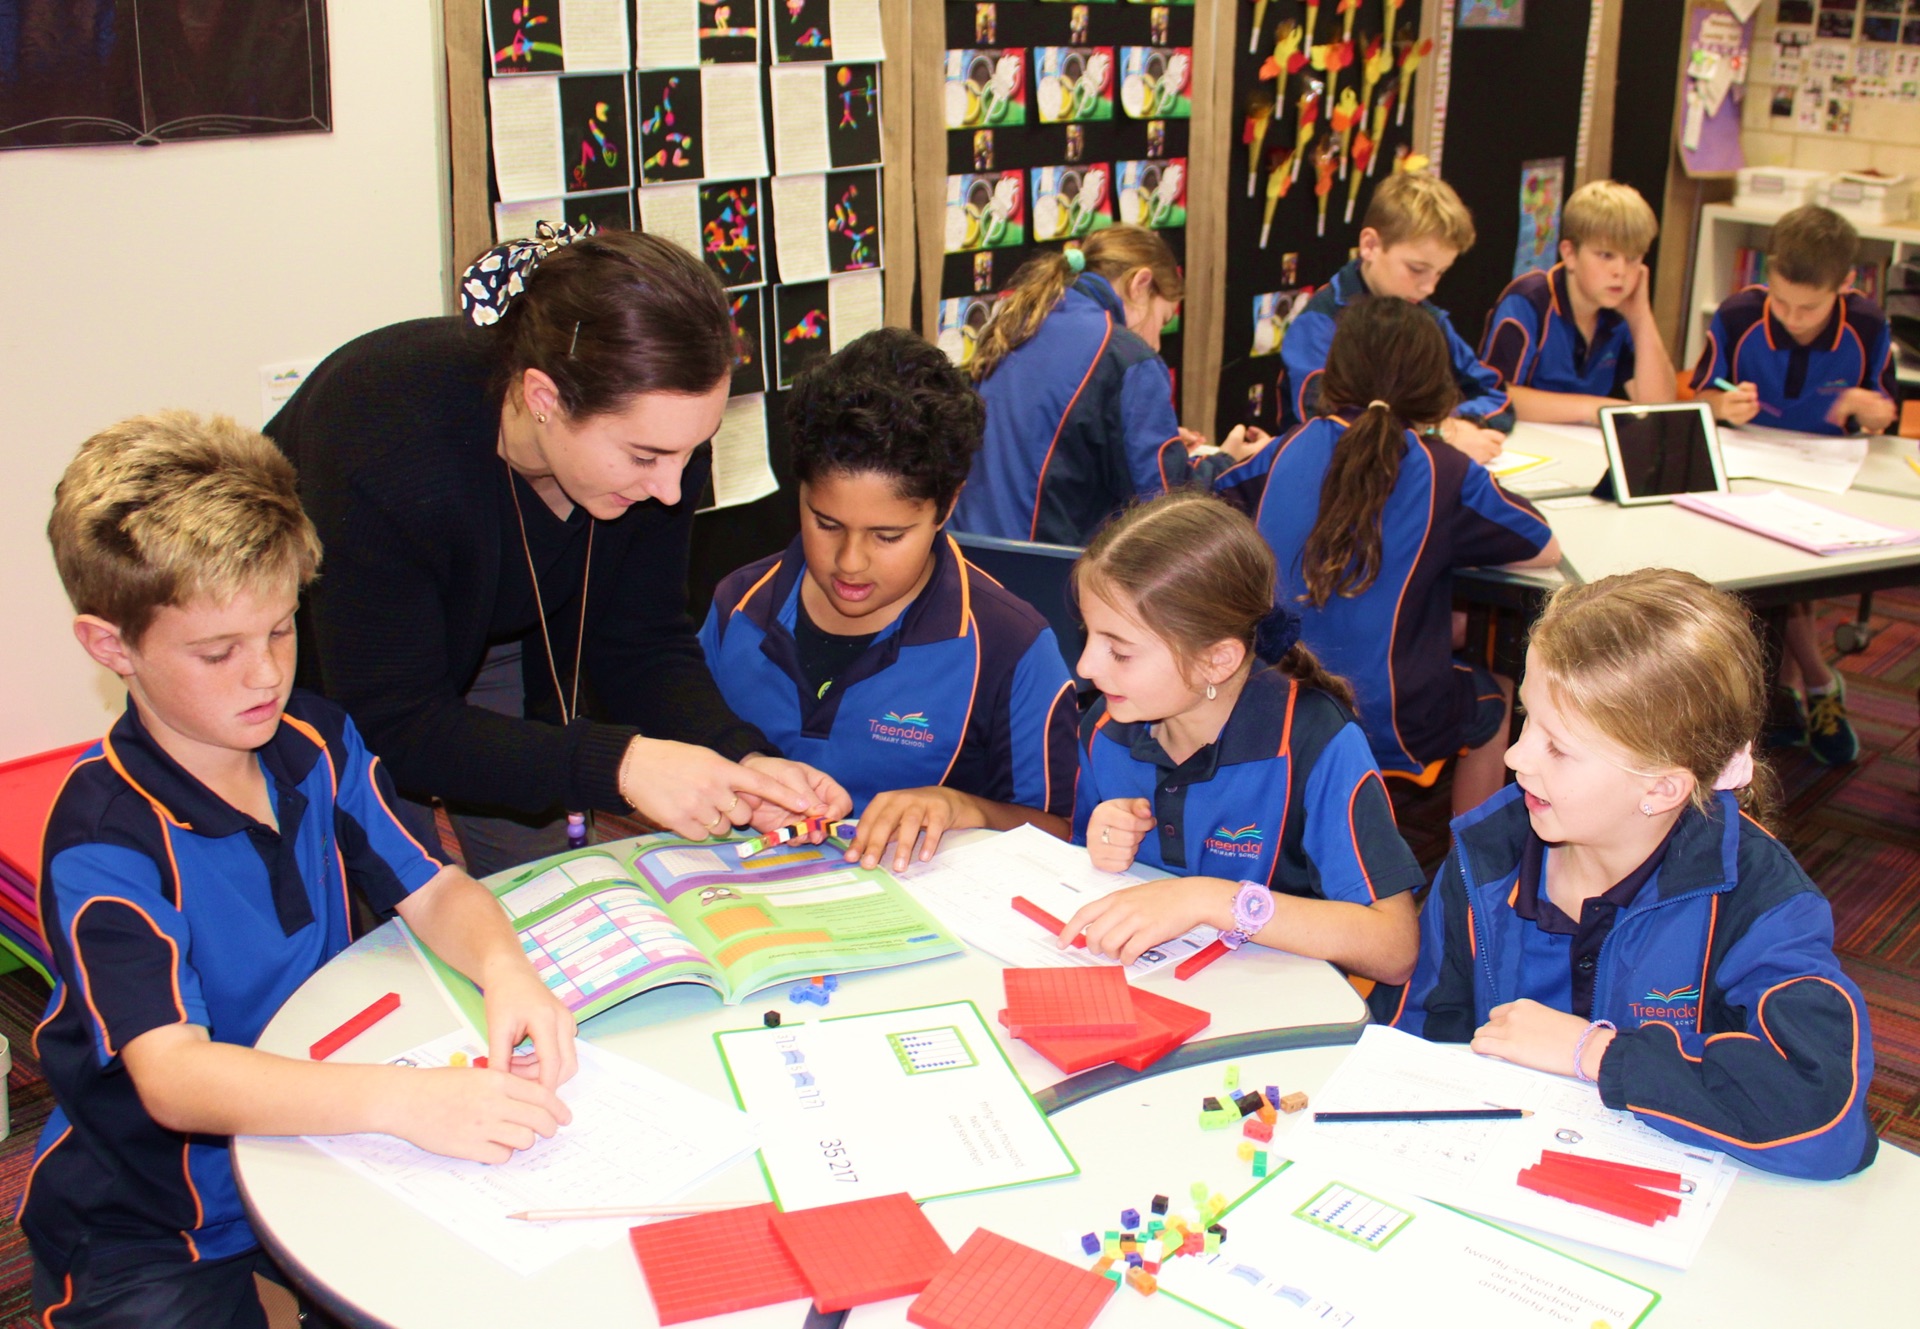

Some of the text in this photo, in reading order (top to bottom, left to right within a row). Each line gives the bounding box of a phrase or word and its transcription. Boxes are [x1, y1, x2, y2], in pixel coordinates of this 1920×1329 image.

[868, 719, 934, 743] Treendale
[872, 733, 925, 749] PRIMARY SCHOOL
[1463, 1245, 1625, 1320] twenty-seven thousand,
[1478, 1278, 1507, 1295] and
[1490, 1271, 1581, 1314] one hundred
